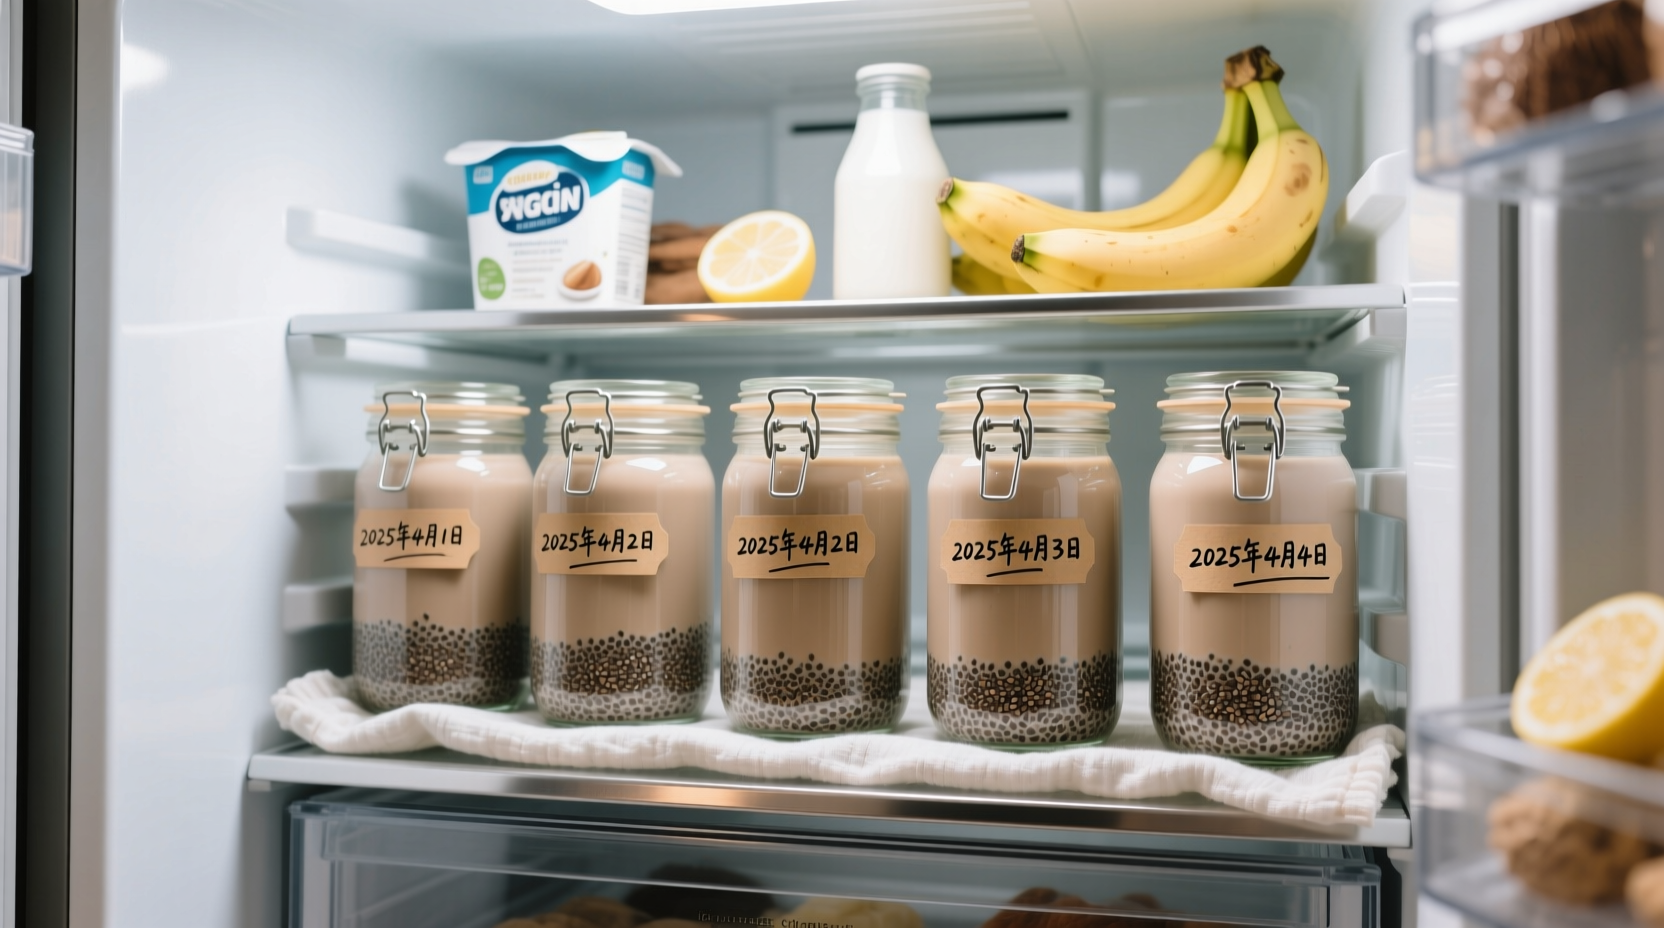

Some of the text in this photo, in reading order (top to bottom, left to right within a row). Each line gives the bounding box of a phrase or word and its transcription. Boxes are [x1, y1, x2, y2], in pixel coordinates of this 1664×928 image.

[360, 521, 462, 550] 2025年4月1日
[541, 525, 653, 557] 2025年4月2日
[737, 527, 859, 561] 2025年4月2日
[951, 531, 1080, 566] 2025年4月3日
[1189, 537, 1327, 573] 2025年4月4日
